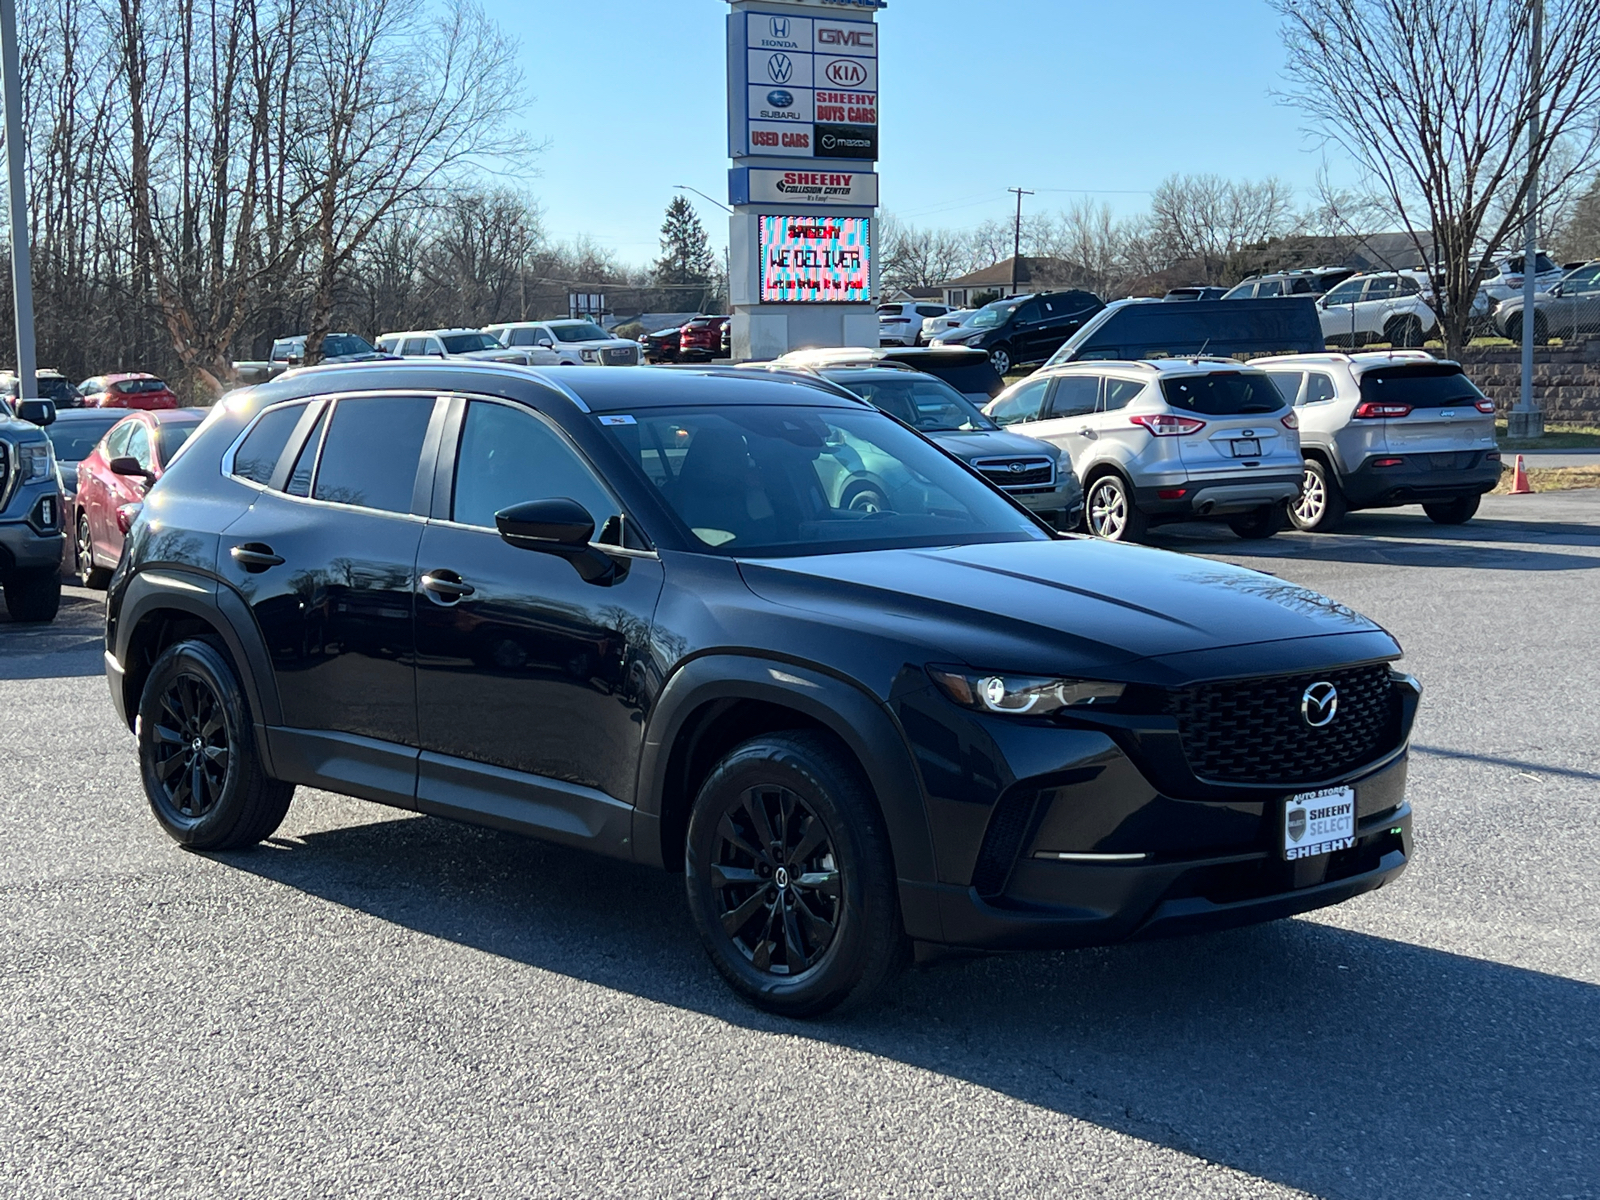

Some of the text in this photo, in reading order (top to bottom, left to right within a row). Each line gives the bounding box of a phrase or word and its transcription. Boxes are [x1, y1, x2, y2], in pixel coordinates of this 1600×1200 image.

[761, 39, 798, 48] HONDA
[818, 28, 874, 48] GMC
[833, 65, 860, 81] KIA
[816, 91, 875, 105] SHEEHY
[760, 110, 800, 120] SUBARU
[817, 105, 876, 124] BUYS CARS
[752, 131, 809, 148] USED CARS
[837, 138, 871, 148] mazda
[784, 172, 853, 187] SHEEHY
[785, 185, 851, 195] COLLISION CENTER
[770, 247, 861, 268] WE DELIVER
[1293, 785, 1350, 802] AUTO STORES
[1309, 803, 1352, 821] SHEEHY
[1310, 815, 1352, 837] SELECT
[1286, 836, 1356, 861] SHEEHY
